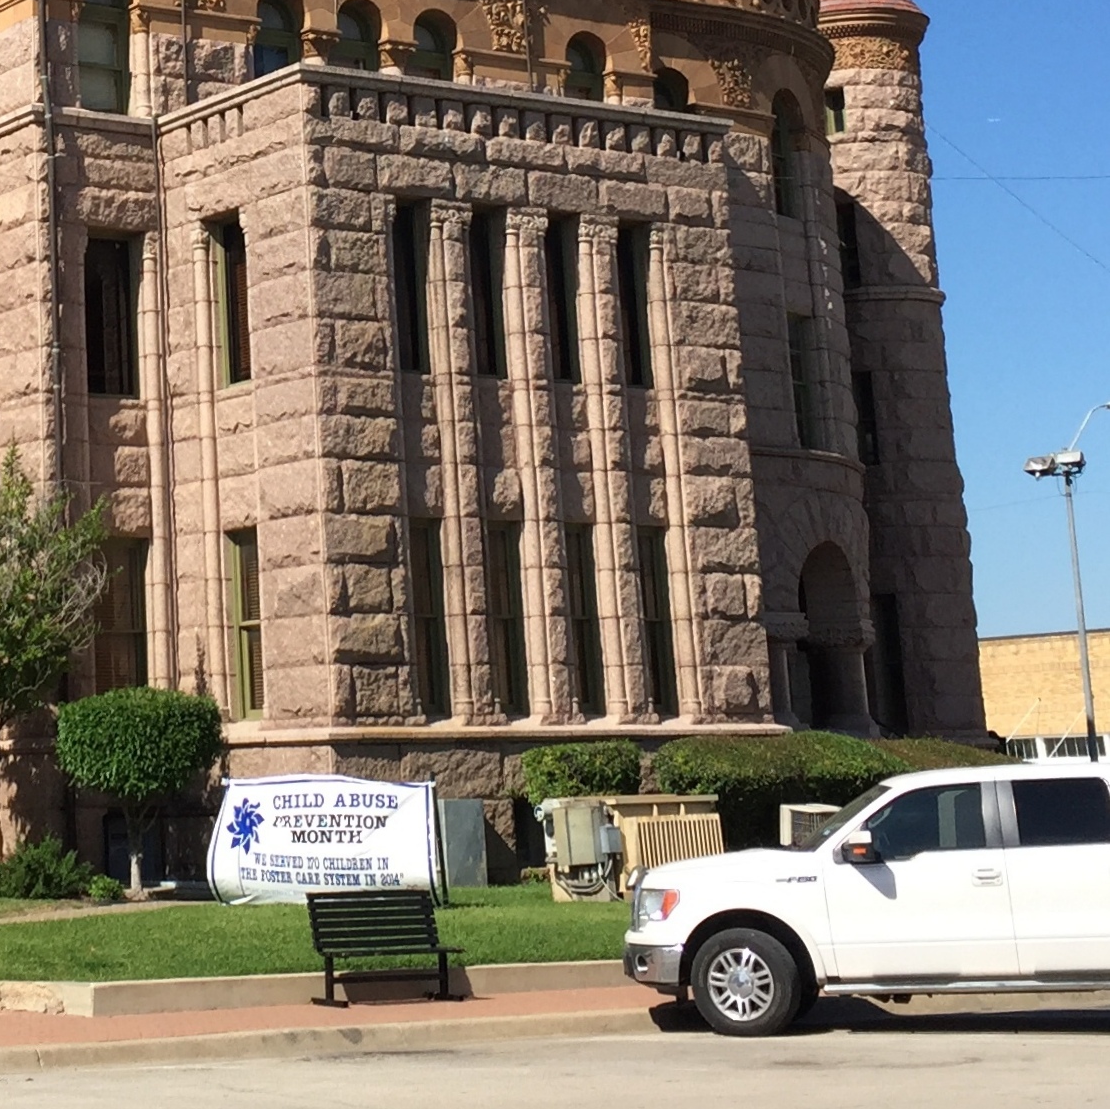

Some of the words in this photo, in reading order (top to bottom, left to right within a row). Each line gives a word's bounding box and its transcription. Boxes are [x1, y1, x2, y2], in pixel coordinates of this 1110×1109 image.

[273, 793, 325, 810] CHILD
[333, 793, 399, 810] ABUSE
[272, 814, 389, 830] PREVENTION
[290, 829, 363, 844] MONTH
[270, 854, 304, 869] SERVED
[322, 857, 373, 871] CHILDREN
[377, 857, 389, 870] IN
[240, 867, 258, 880] THE
[260, 869, 293, 884] FOSTER
[295, 872, 321, 885] CARE
[323, 872, 361, 886] SYSTEM
[364, 873, 377, 886] IN
